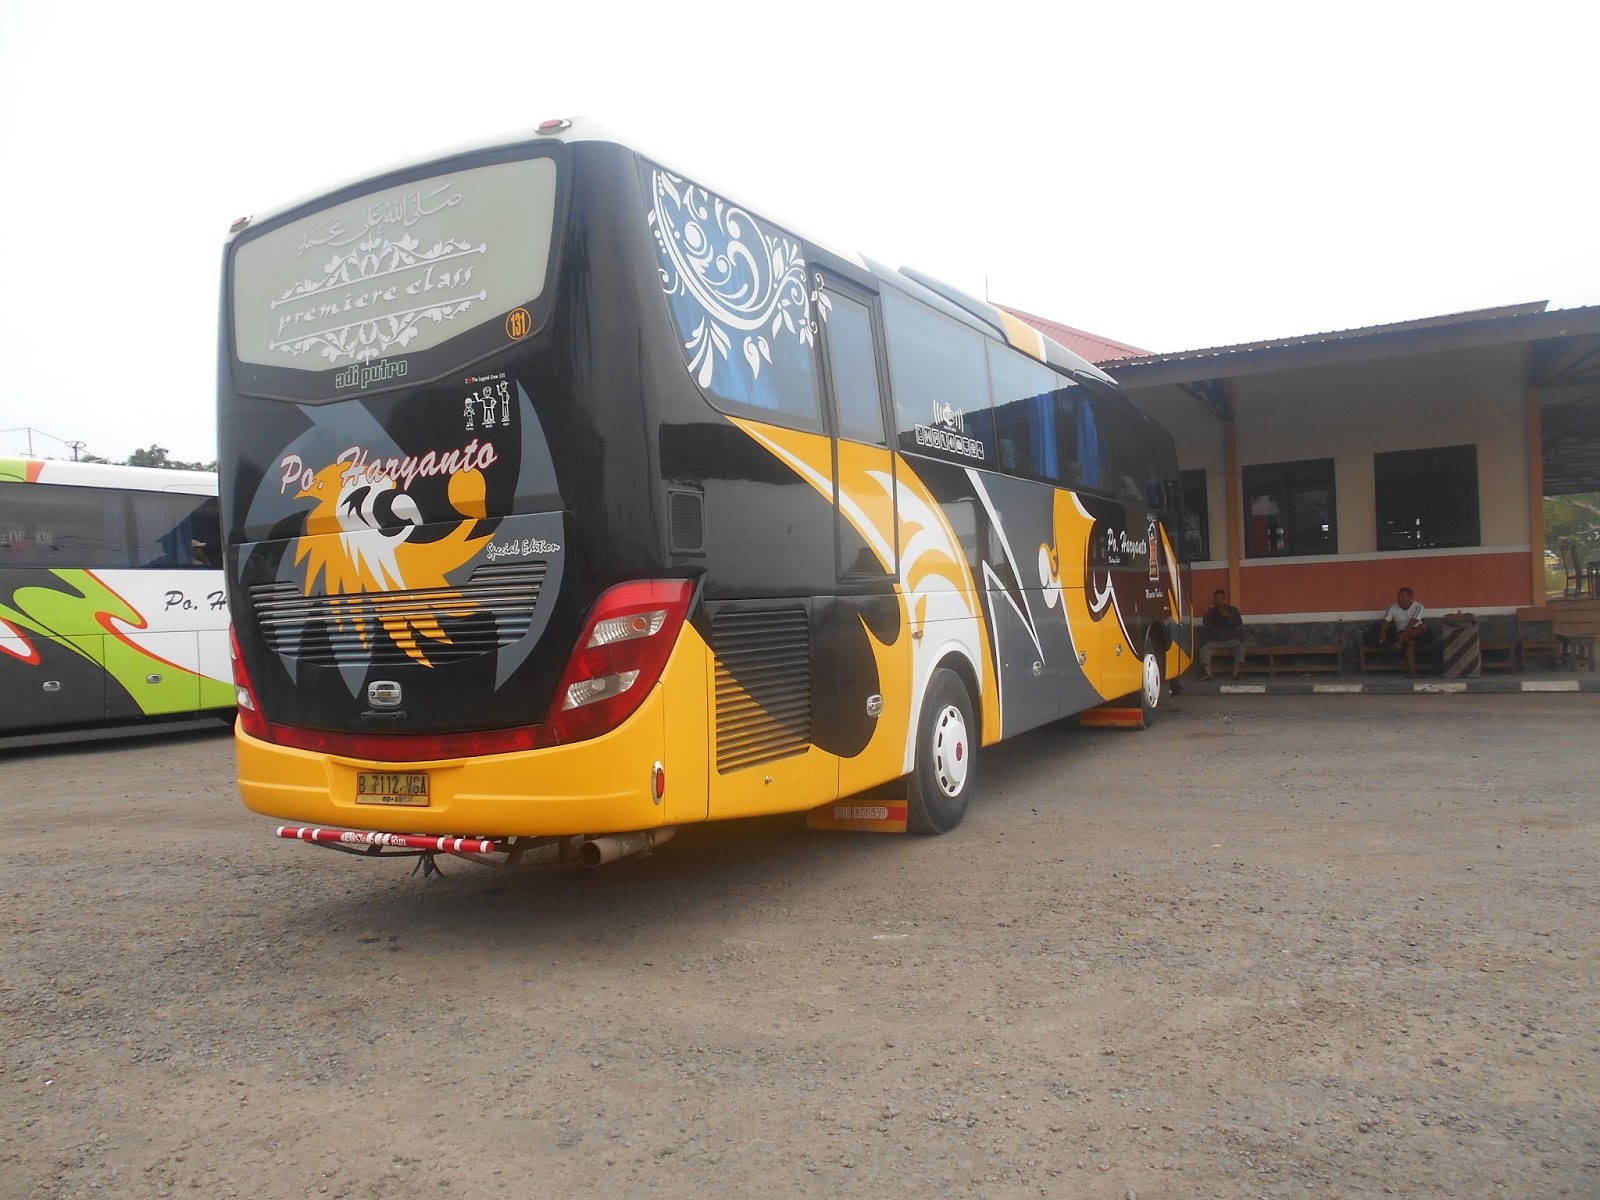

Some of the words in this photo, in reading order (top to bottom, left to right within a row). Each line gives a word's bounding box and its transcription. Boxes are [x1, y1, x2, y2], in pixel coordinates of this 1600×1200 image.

[277, 285, 398, 339] premiere
[406, 264, 475, 296] class
[510, 311, 527, 337] 131
[279, 454, 325, 495] Po.
[336, 438, 498, 491] Haryanto
[486, 539, 520, 562] Special
[521, 537, 561, 556] Edition
[164, 590, 198, 612] Po.
[359, 775, 366, 793] B
[851, 806, 889, 820] LEGEND
[391, 835, 407, 847] Run
